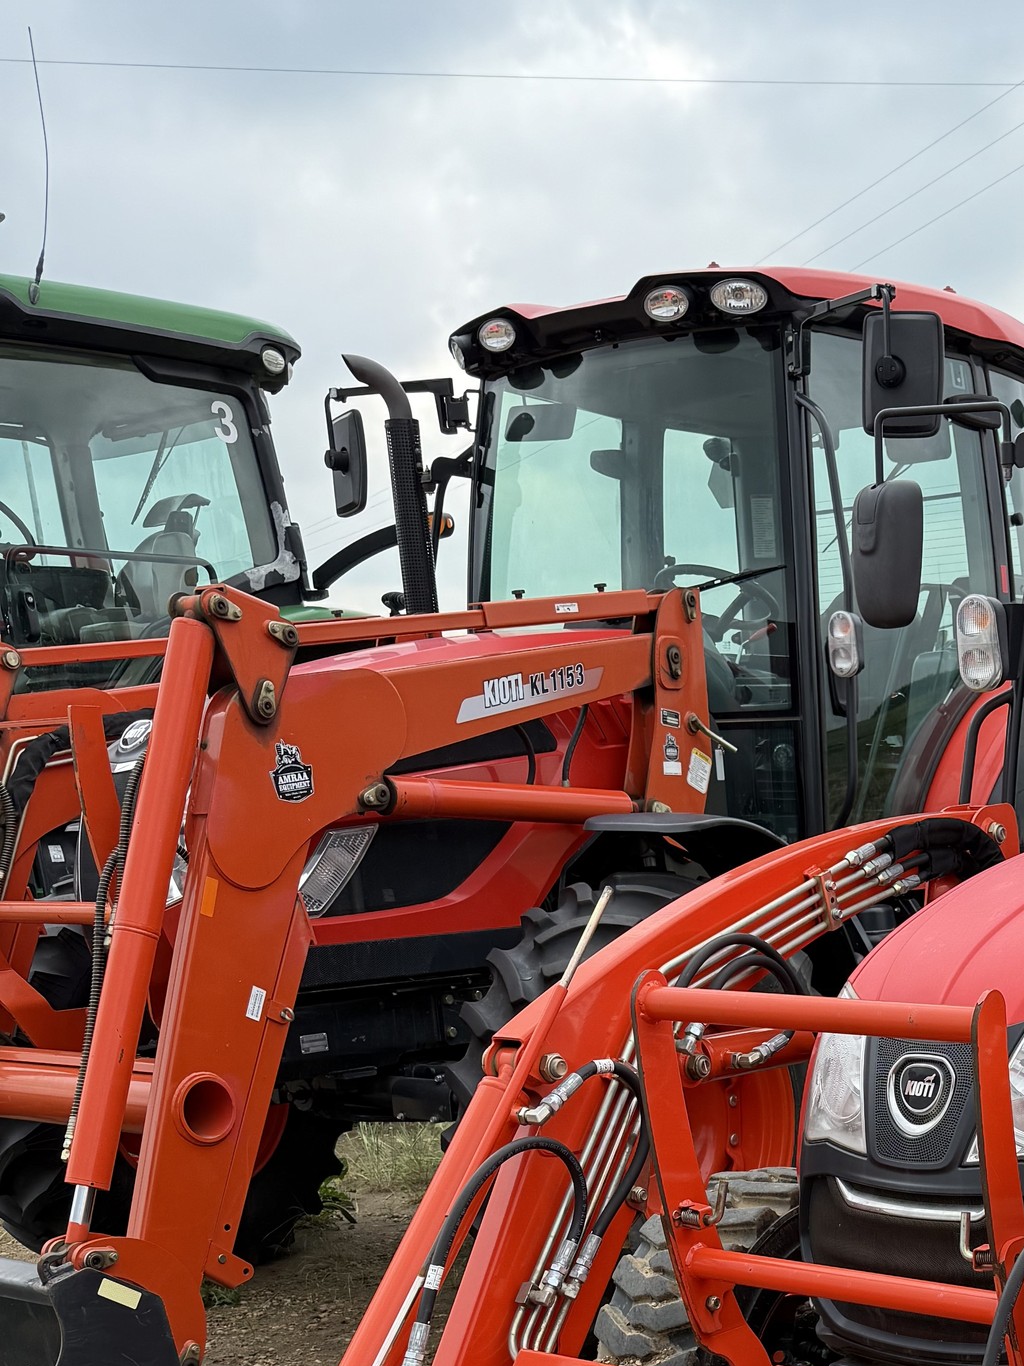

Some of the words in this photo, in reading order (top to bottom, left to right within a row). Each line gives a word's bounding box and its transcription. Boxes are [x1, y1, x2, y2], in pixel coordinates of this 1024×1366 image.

[211, 400, 239, 444] 3
[483, 672, 525, 709] KIOTI
[278, 771, 310, 785] AMRAA
[279, 780, 311, 792] EQUIPMENT
[904, 1079, 936, 1098] KIOTI
